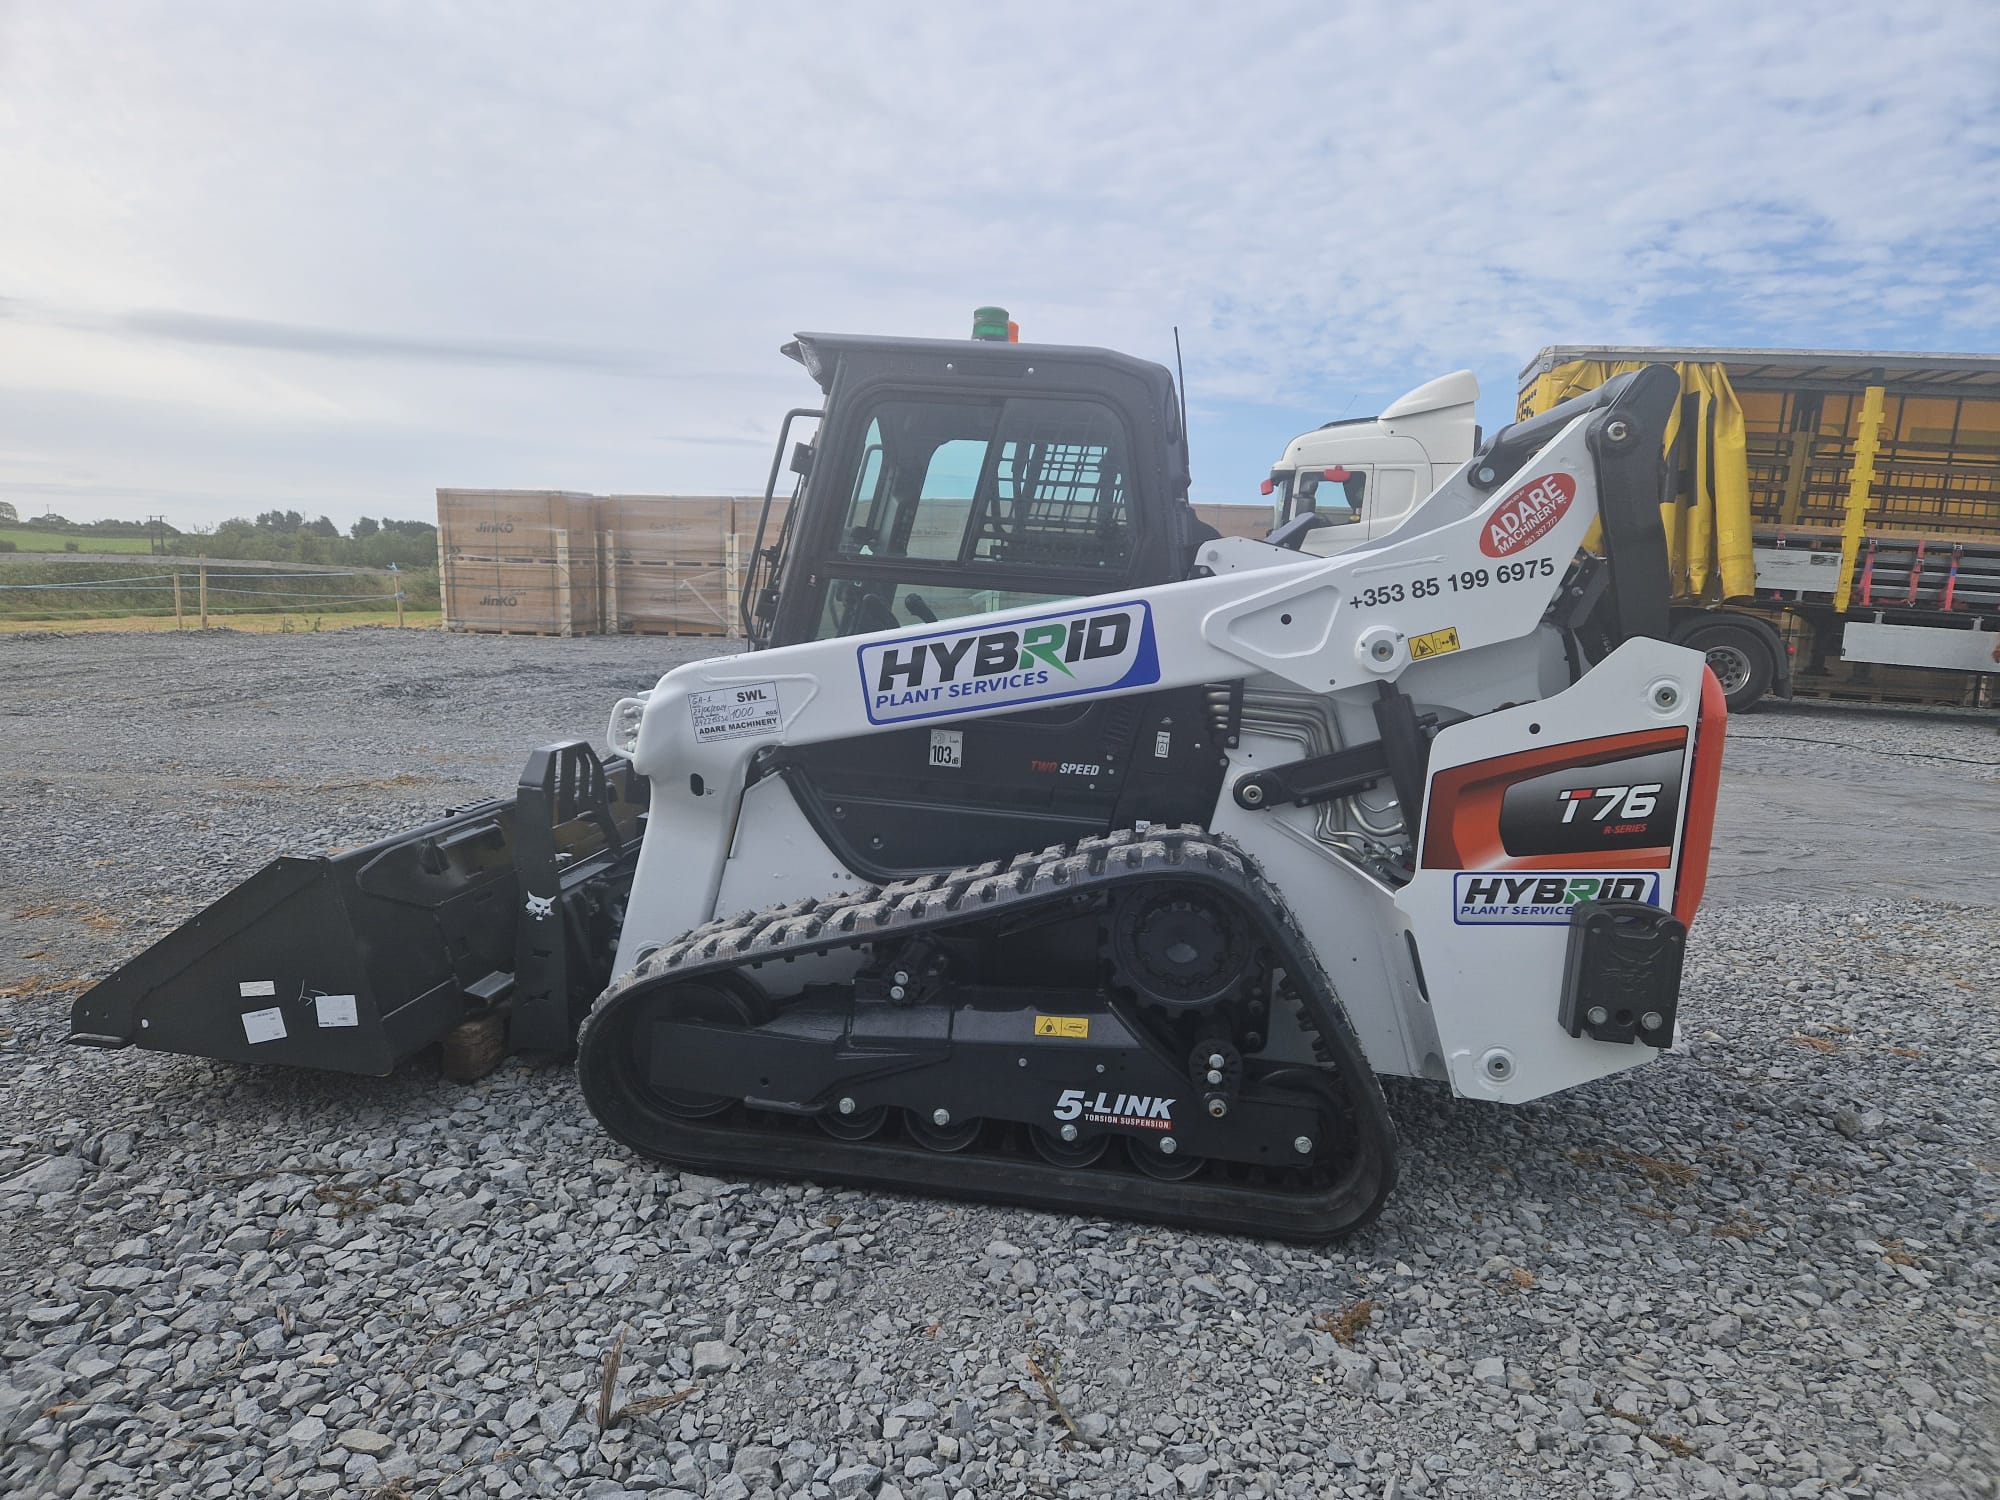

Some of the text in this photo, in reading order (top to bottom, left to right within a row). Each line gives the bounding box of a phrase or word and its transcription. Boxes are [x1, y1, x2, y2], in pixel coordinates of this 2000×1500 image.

[1490, 475, 1562, 547] ADARE
[1498, 499, 1557, 554] MACHINERY
[1349, 557, 1555, 610] +353 85 199 6975
[878, 612, 1131, 692] HYBRID
[736, 690, 767, 703] SWL
[875, 670, 1049, 709] PLANT SERVICES
[699, 724, 727, 735] ADARE
[728, 717, 778, 731] MACHINERY
[932, 744, 952, 764] 103
[1031, 760, 1100, 776] TWO SPEED
[1557, 783, 1662, 824] T76
[1603, 823, 1648, 835] R-SERIES
[1464, 877, 1646, 905] HYBRID
[1460, 905, 1574, 915] PLANT SERVICE
[1053, 1089, 1177, 1121] 5-LINK
[1085, 1113, 1170, 1129] TORSION SUSPENSION
